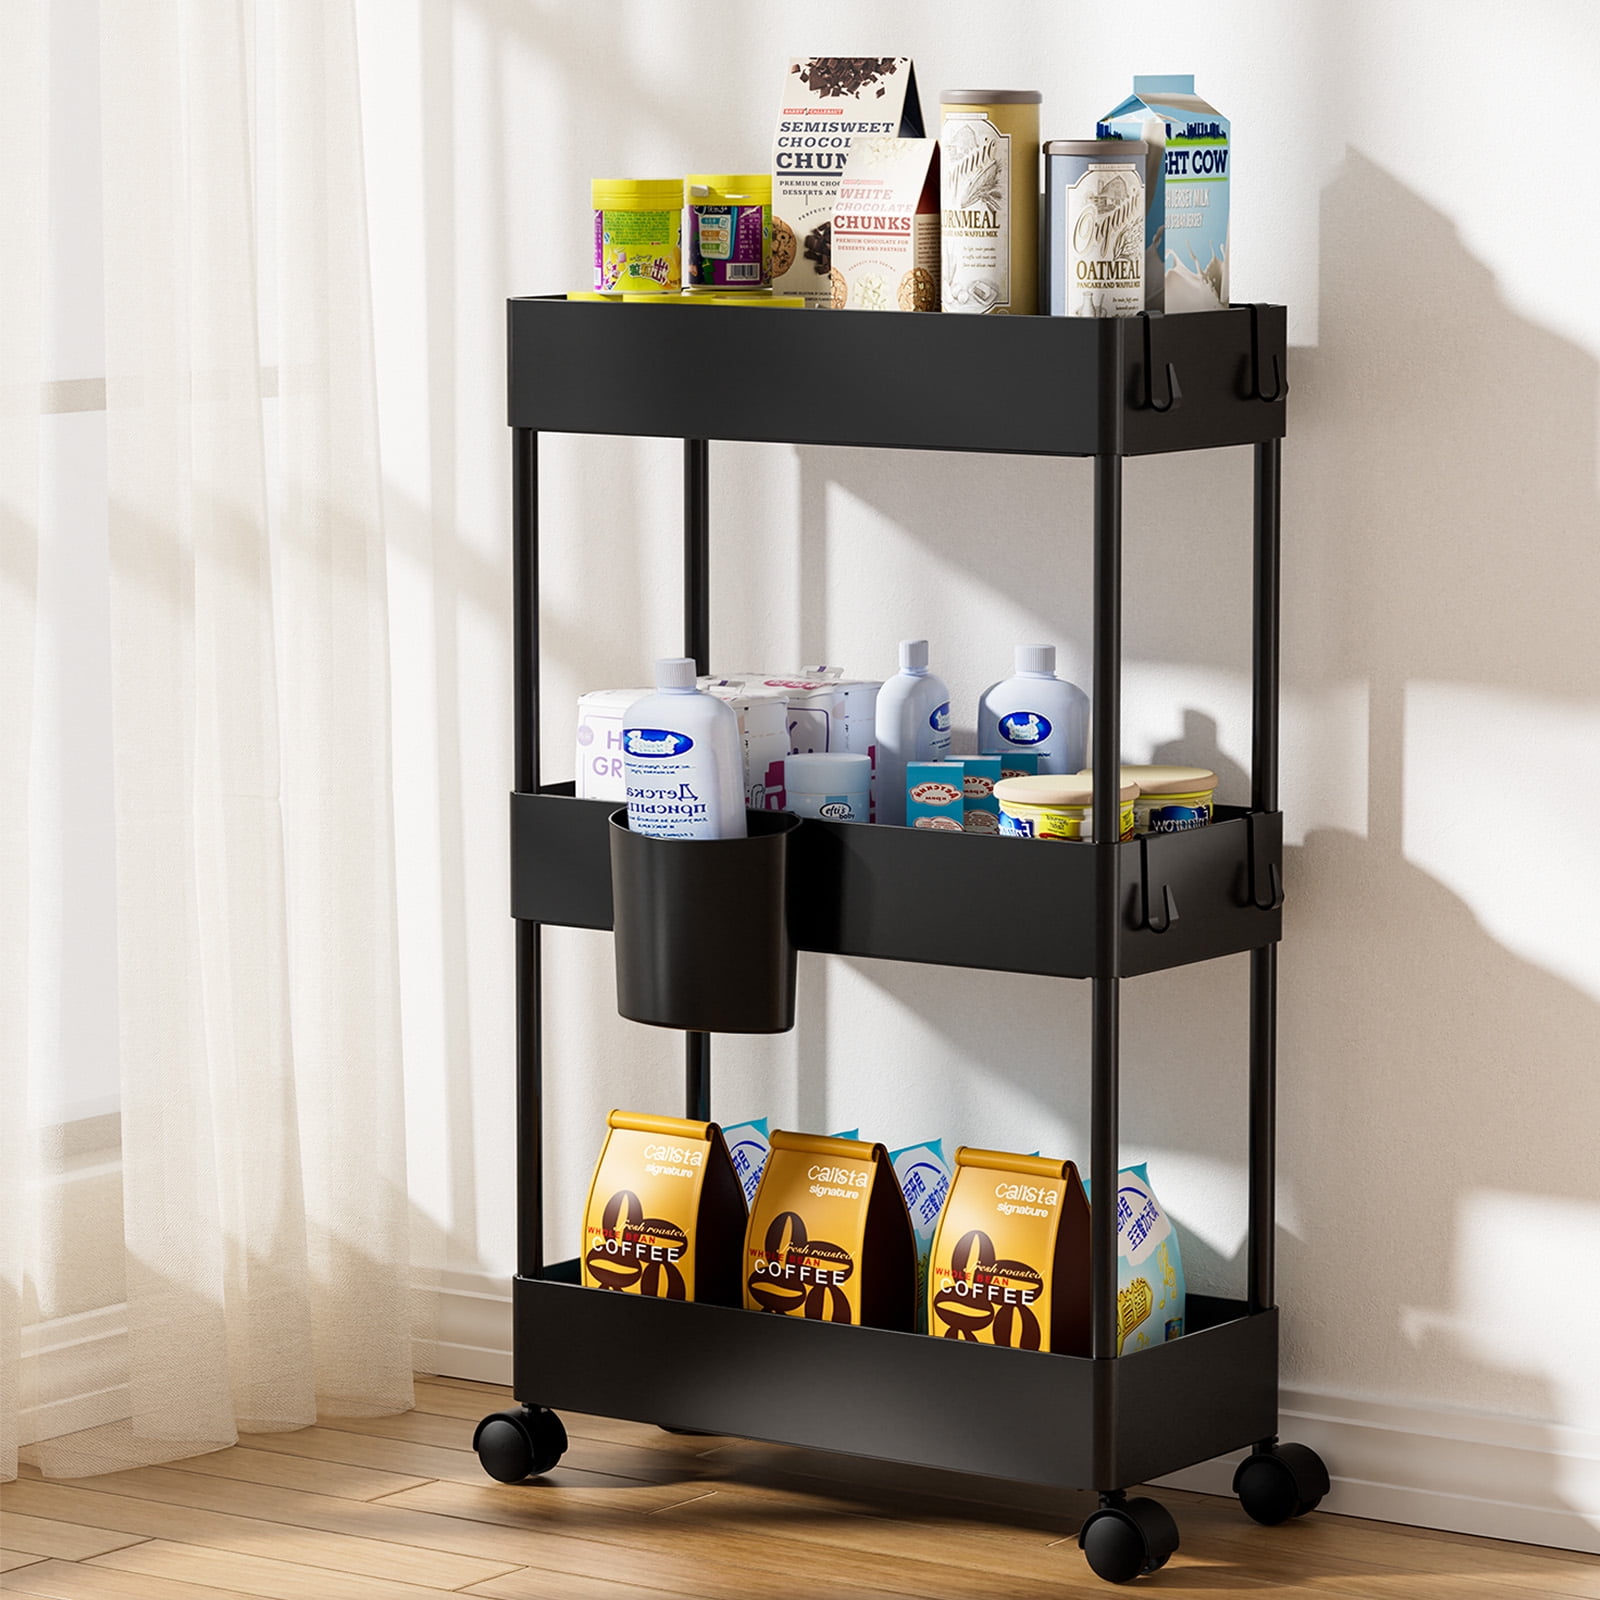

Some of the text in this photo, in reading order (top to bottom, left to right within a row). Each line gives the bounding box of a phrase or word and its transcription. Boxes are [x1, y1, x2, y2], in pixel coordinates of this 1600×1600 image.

[780, 121, 894, 133] SEMISWEET
[1192, 149, 1228, 174] COW
[840, 188, 893, 200] WHITE
[835, 202, 913, 213] CHOCOLATE
[834, 215, 911, 231] CHUNKS
[1073, 188, 1140, 258] Organic
[1076, 260, 1141, 280] OATMEAL
[593, 756, 622, 778] GR
[645, 1163, 694, 1178] signature
[809, 1184, 860, 1200] signature
[996, 1202, 1049, 1218] signature
[587, 1226, 656, 1244] WHOLE BEAN
[646, 1224, 690, 1237] roasted
[591, 1236, 680, 1263] COFFEE
[749, 1248, 821, 1267] WHOLE BEAN
[811, 1247, 855, 1260] roasted
[754, 1259, 846, 1286] COFFEE
[935, 1267, 1009, 1286] WHOLE BEAN
[999, 1267, 1046, 1280] roasted
[940, 1278, 1035, 1306] COFFEE
